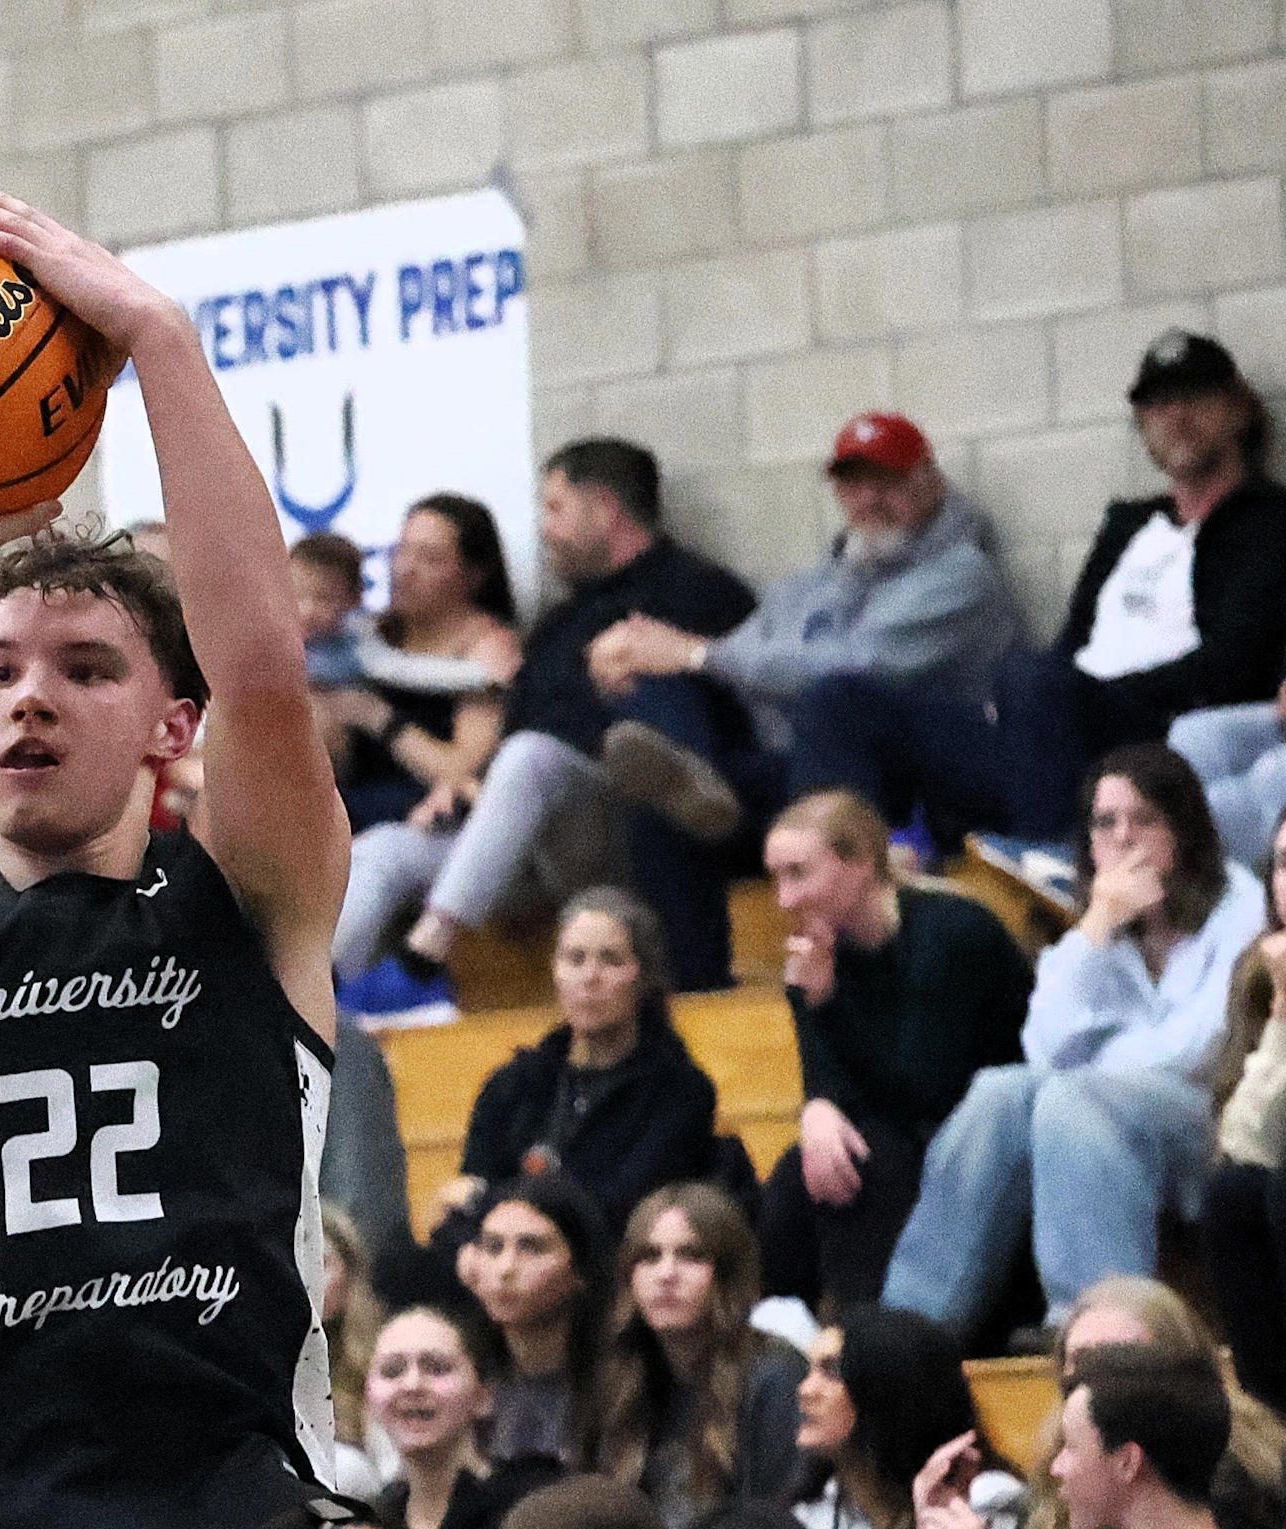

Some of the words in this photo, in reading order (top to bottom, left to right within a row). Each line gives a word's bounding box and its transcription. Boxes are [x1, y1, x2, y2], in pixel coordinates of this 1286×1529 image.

[195, 268, 377, 372] ERSITY
[397, 248, 523, 342] PREP
[40, 374, 85, 437] EV
